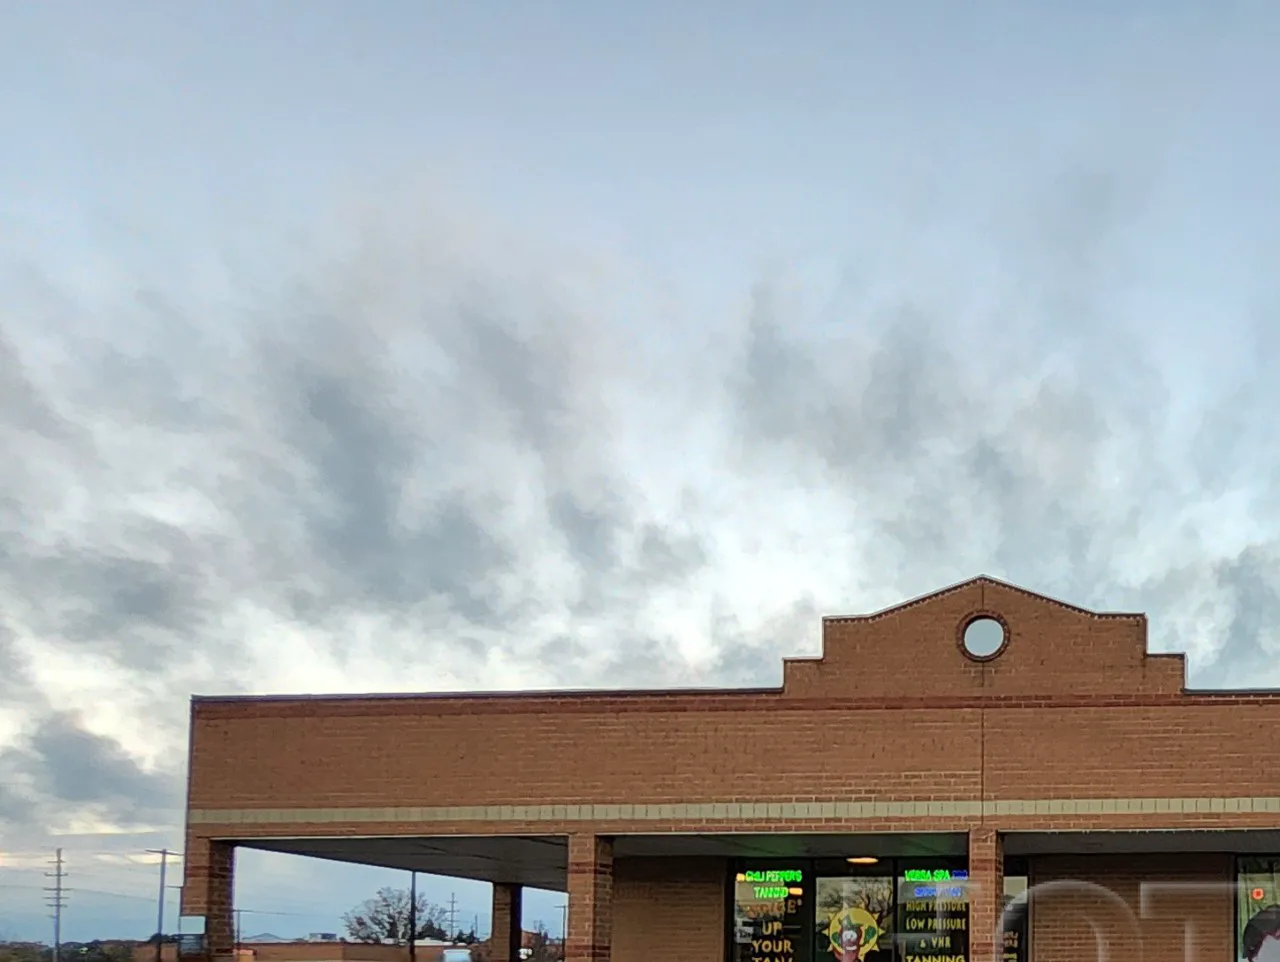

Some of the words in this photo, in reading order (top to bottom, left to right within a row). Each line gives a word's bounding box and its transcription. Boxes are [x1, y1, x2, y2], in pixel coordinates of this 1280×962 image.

[933, 869, 951, 881] SPA
[929, 900, 966, 912] PRESSURE
[762, 921, 783, 936] UP
[906, 918, 925, 931] LOW
[928, 918, 966, 931] PRESSURE
[752, 939, 794, 954] YOUR
